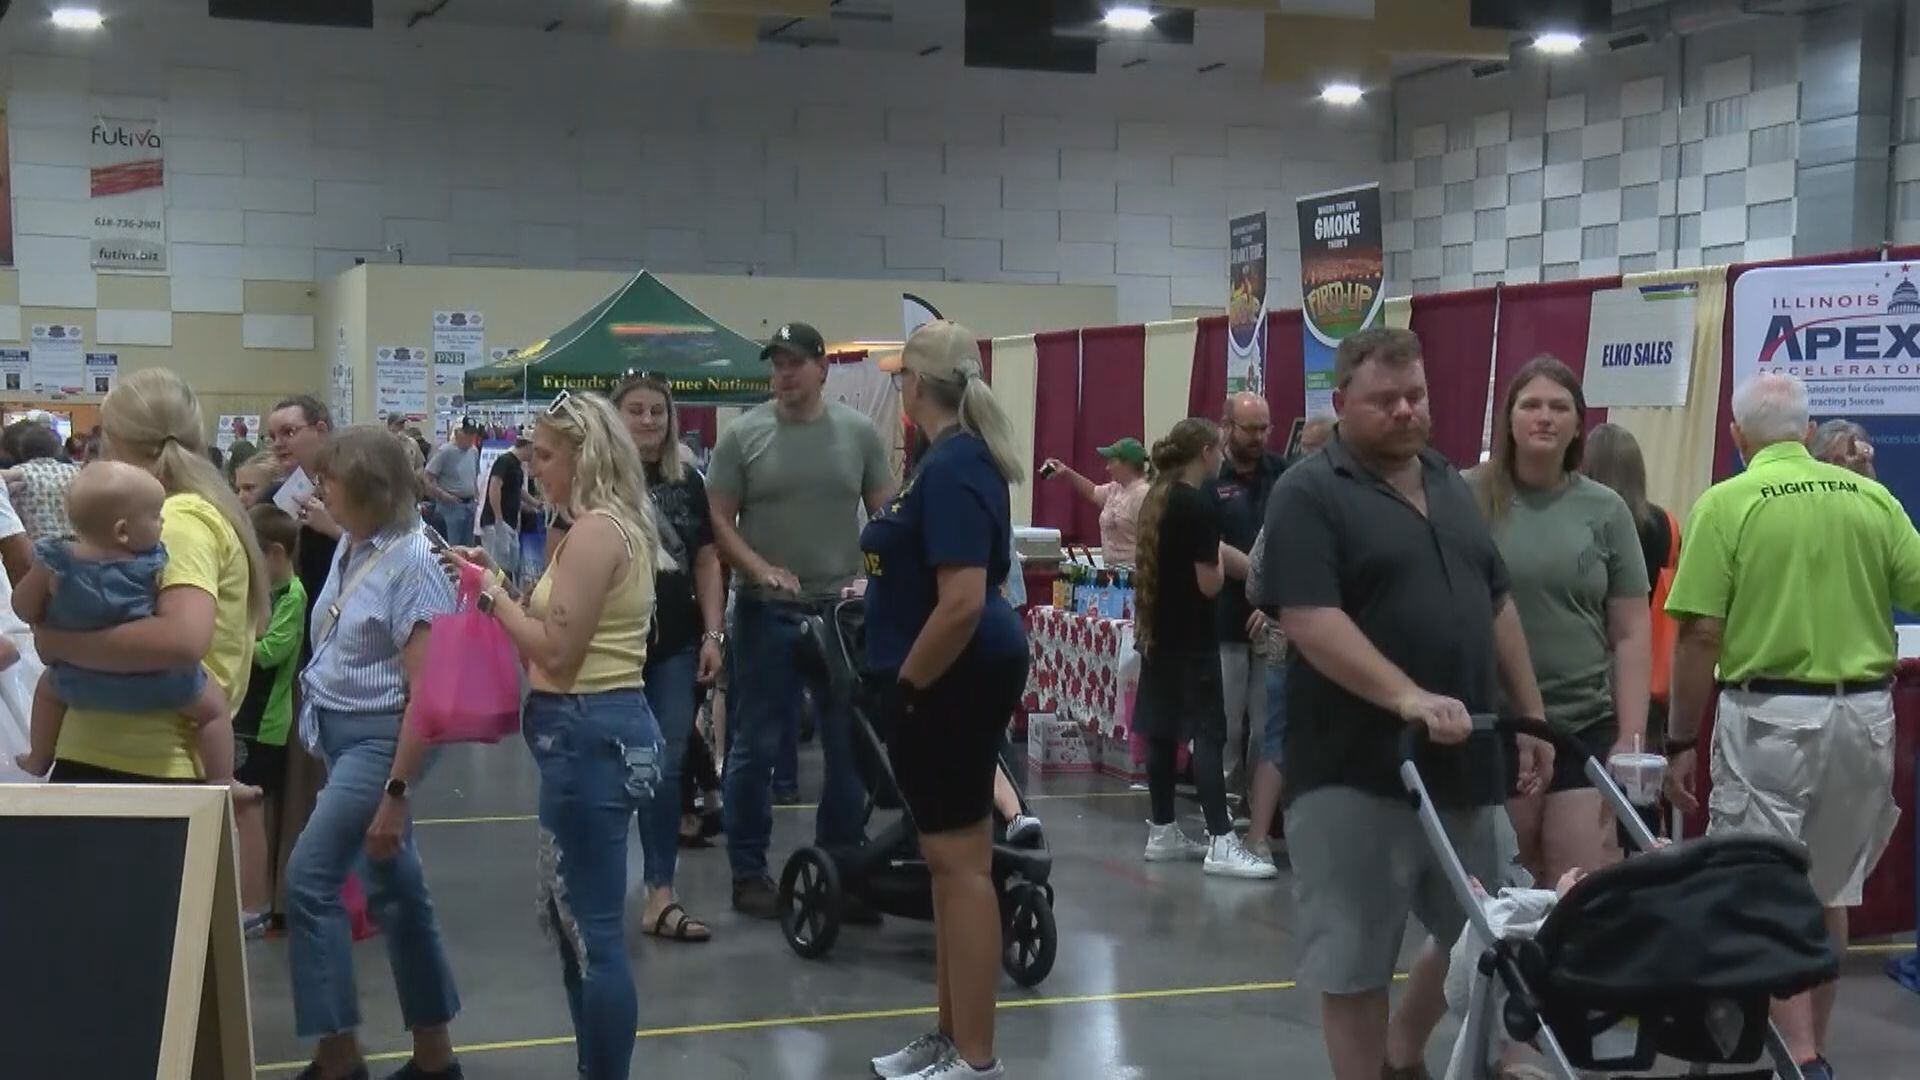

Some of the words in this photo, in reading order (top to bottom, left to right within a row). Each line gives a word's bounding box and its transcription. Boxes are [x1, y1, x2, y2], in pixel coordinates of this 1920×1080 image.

[91, 126, 161, 148] futiva
[99, 247, 160, 262] futiva.biz
[1772, 294, 1880, 309] ILLINOIS
[1758, 315, 1920, 362] APEX
[438, 353, 463, 364] PNB
[1602, 342, 1632, 368] ELKO
[1633, 340, 1673, 367] SALES
[542, 374, 606, 390] Friends
[706, 376, 769, 392] Nationa
[1848, 384, 1861, 394] for
[1863, 384, 1920, 394] Governmen
[1807, 397, 1847, 408] tracting
[1848, 397, 1885, 407] Success
[1760, 480, 1815, 498] FLIGHT
[1817, 480, 1859, 494] TEAM
